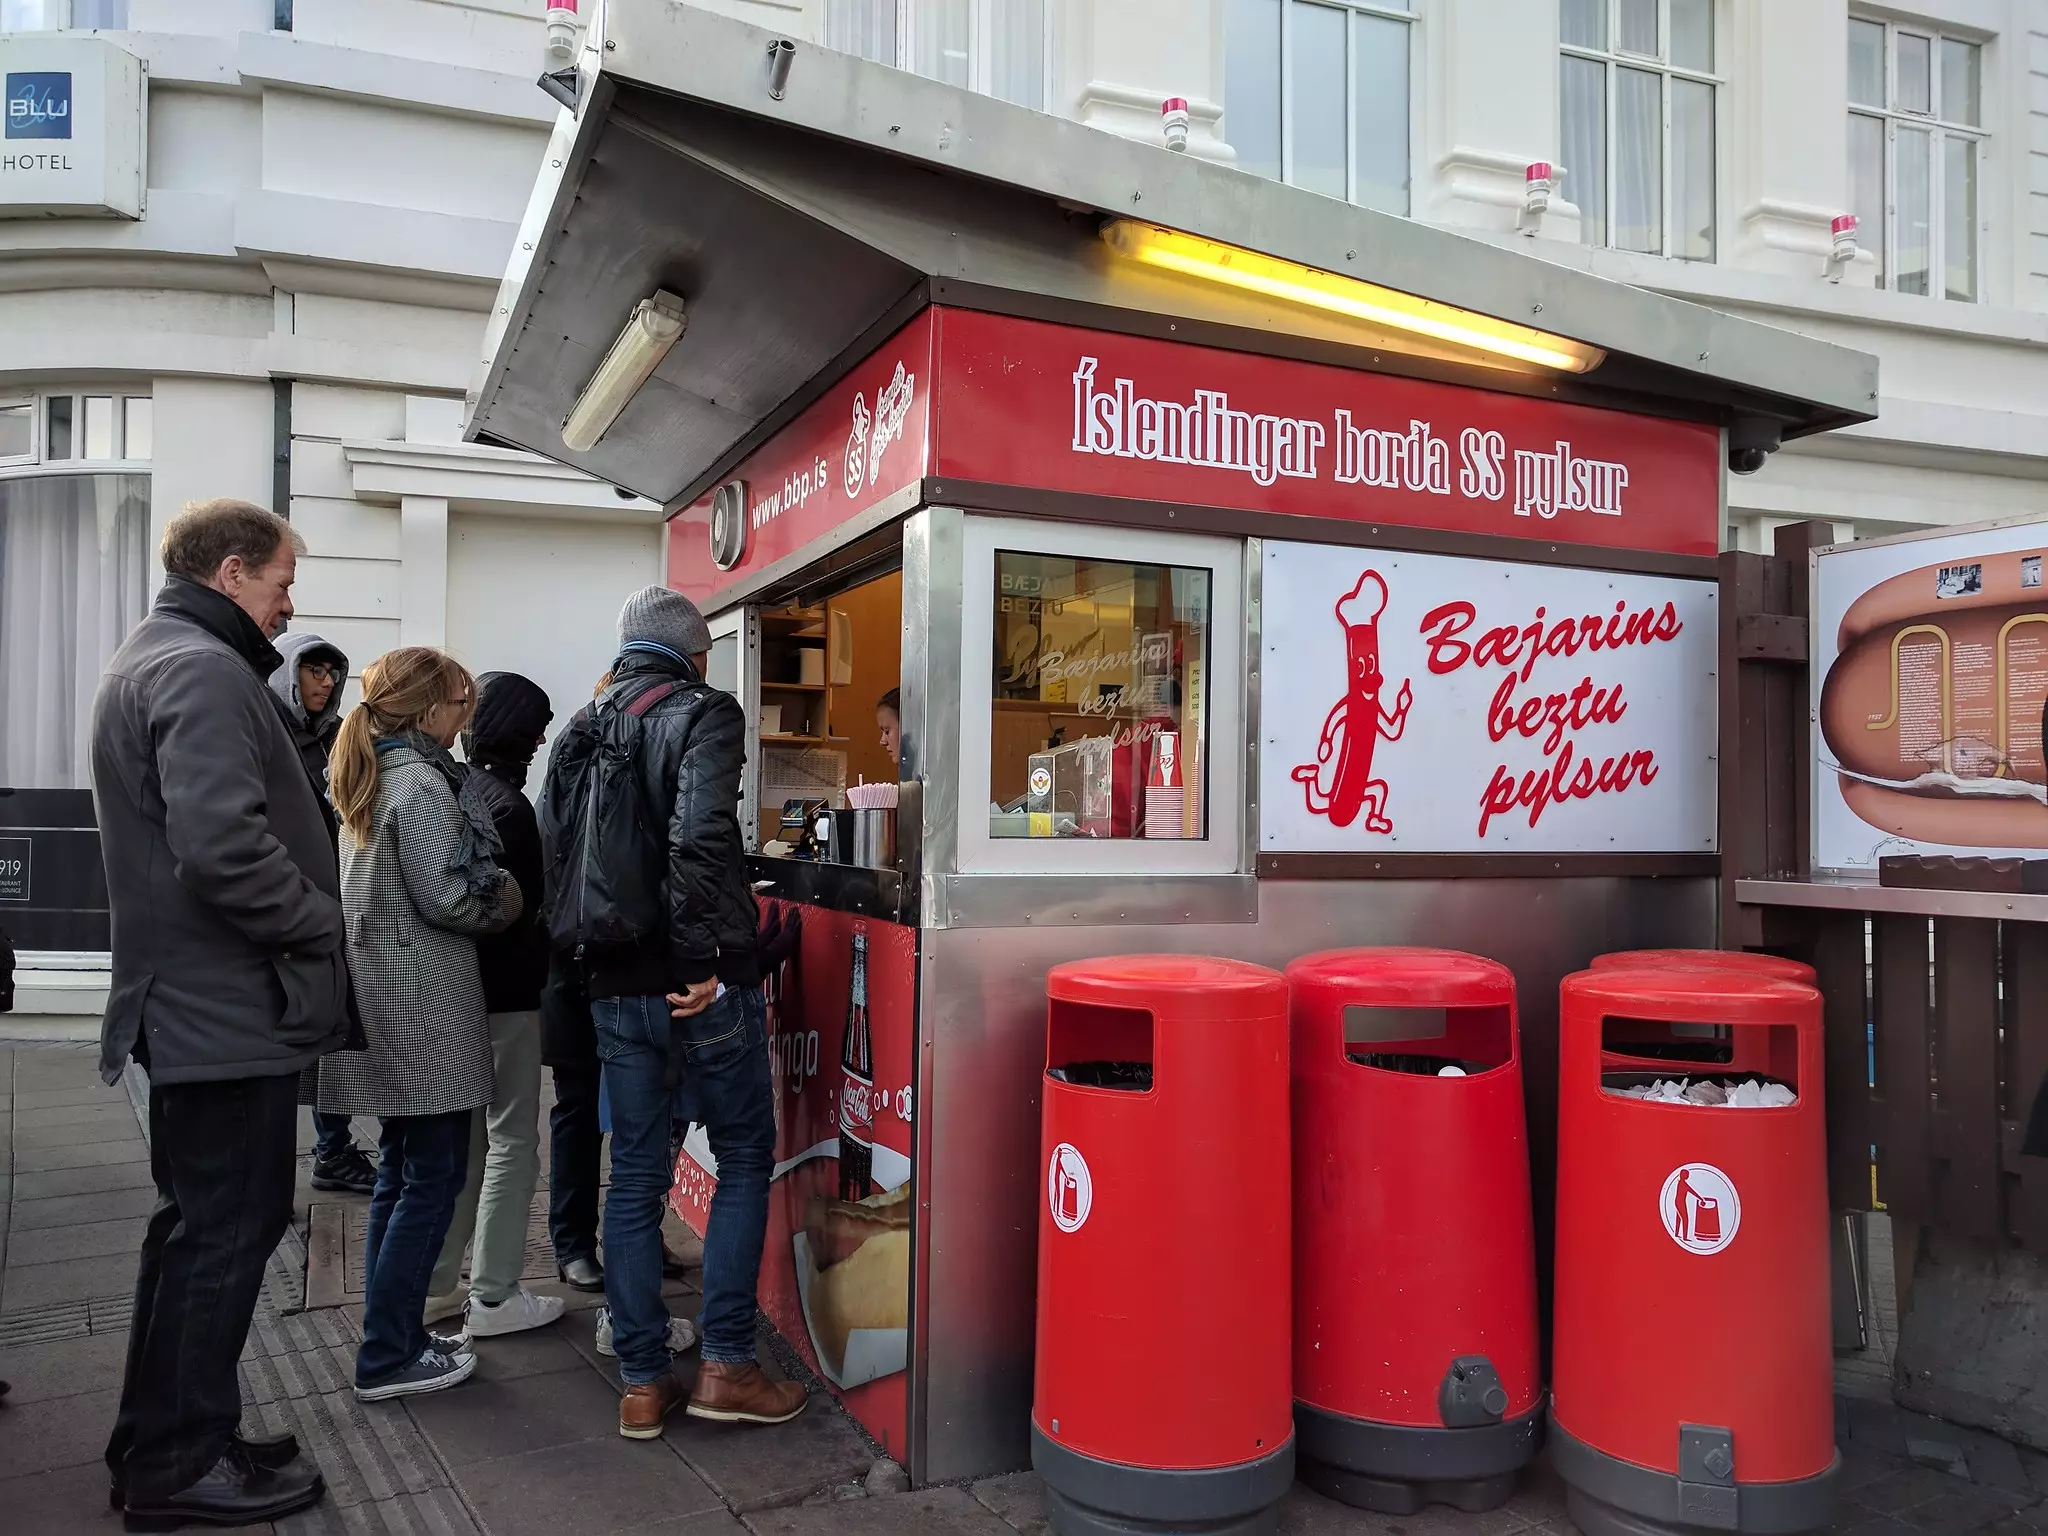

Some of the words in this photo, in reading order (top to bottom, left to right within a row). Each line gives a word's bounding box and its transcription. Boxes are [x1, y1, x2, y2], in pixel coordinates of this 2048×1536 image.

[10, 100, 68, 117] BLU
[3, 155, 72, 170] HOTEL
[847, 446, 863, 486] SS
[1072, 356, 1325, 487] Íslendingar
[1334, 408, 1451, 495] borða
[1459, 427, 1506, 501] SS
[1513, 440, 1629, 519] pylsur
[752, 455, 828, 531] www.bbp.is
[1419, 600, 1684, 683] Bæjarins
[1487, 671, 1629, 756] beztu
[1478, 740, 1660, 838] pylsur
[768, 1017, 819, 1094] dinga
